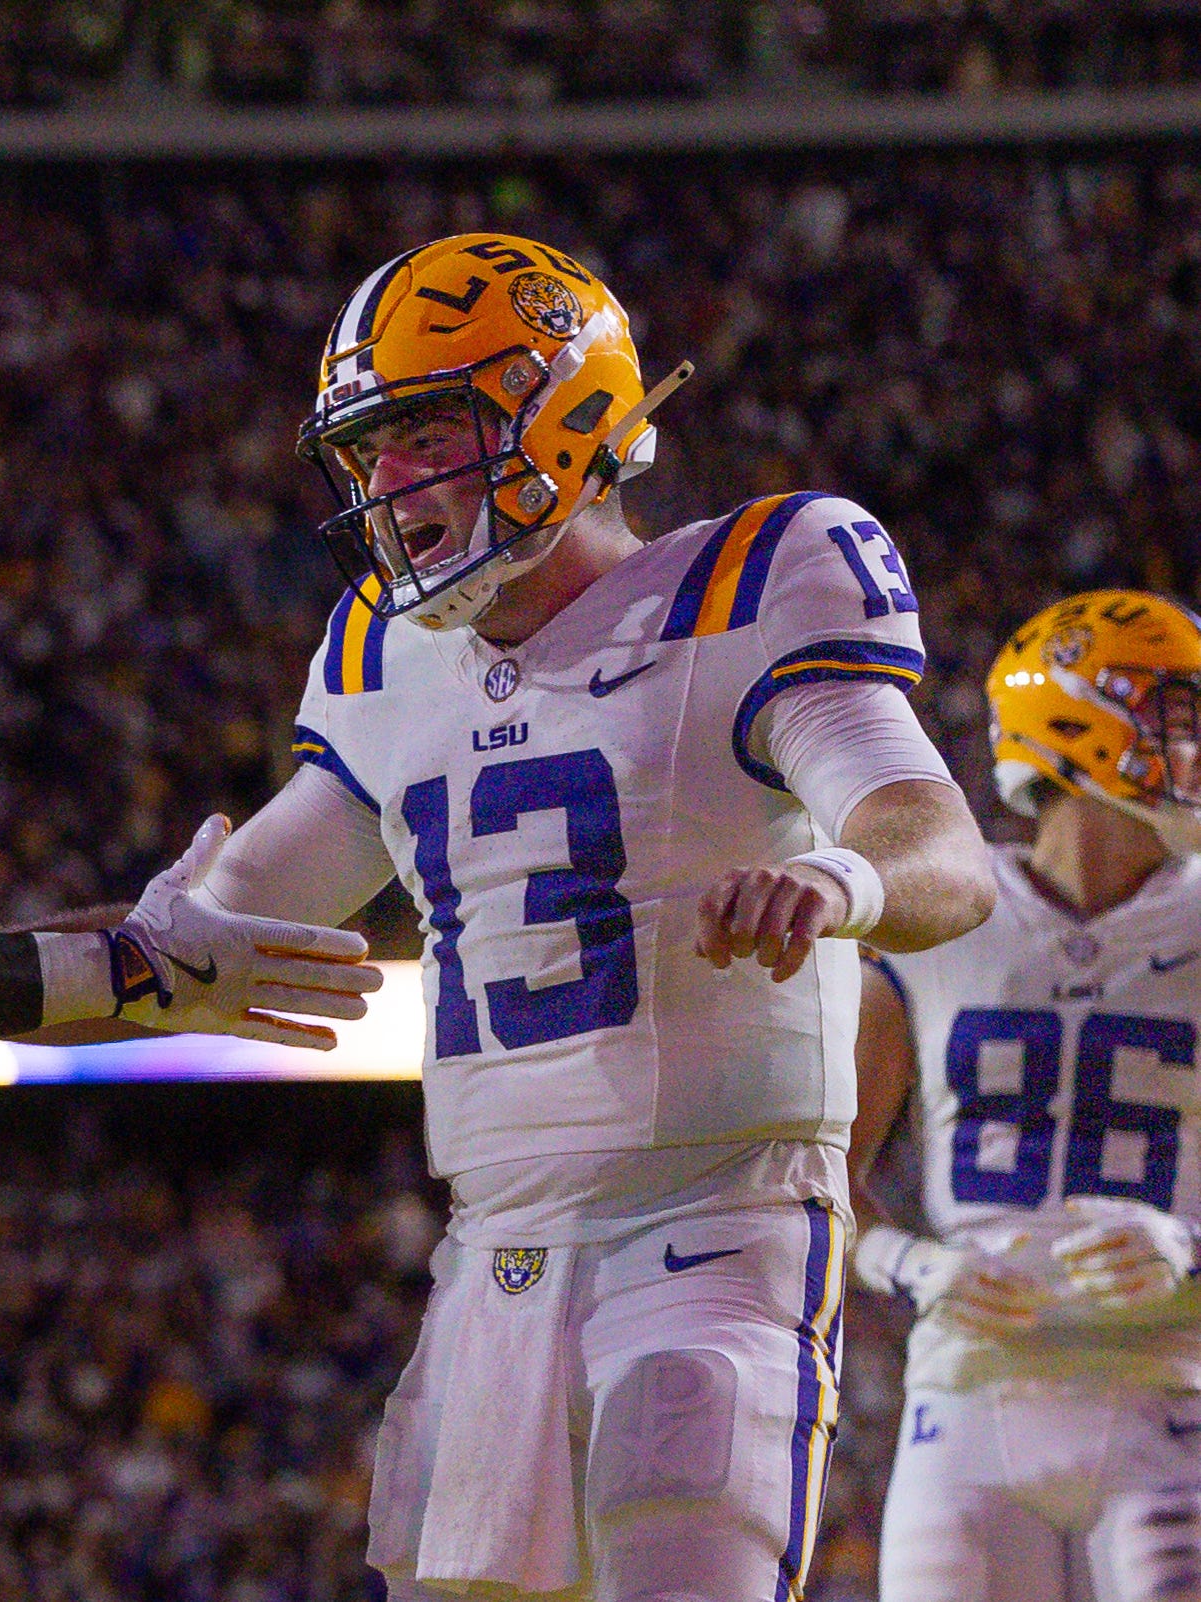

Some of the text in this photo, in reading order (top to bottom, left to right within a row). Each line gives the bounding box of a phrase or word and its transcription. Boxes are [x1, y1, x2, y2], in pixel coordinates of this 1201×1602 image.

[415, 241, 592, 314] LSU
[827, 521, 919, 619] 13
[473, 722, 528, 752] LSU
[400, 748, 639, 1060] 13
[947, 1008, 1195, 1211] 86
